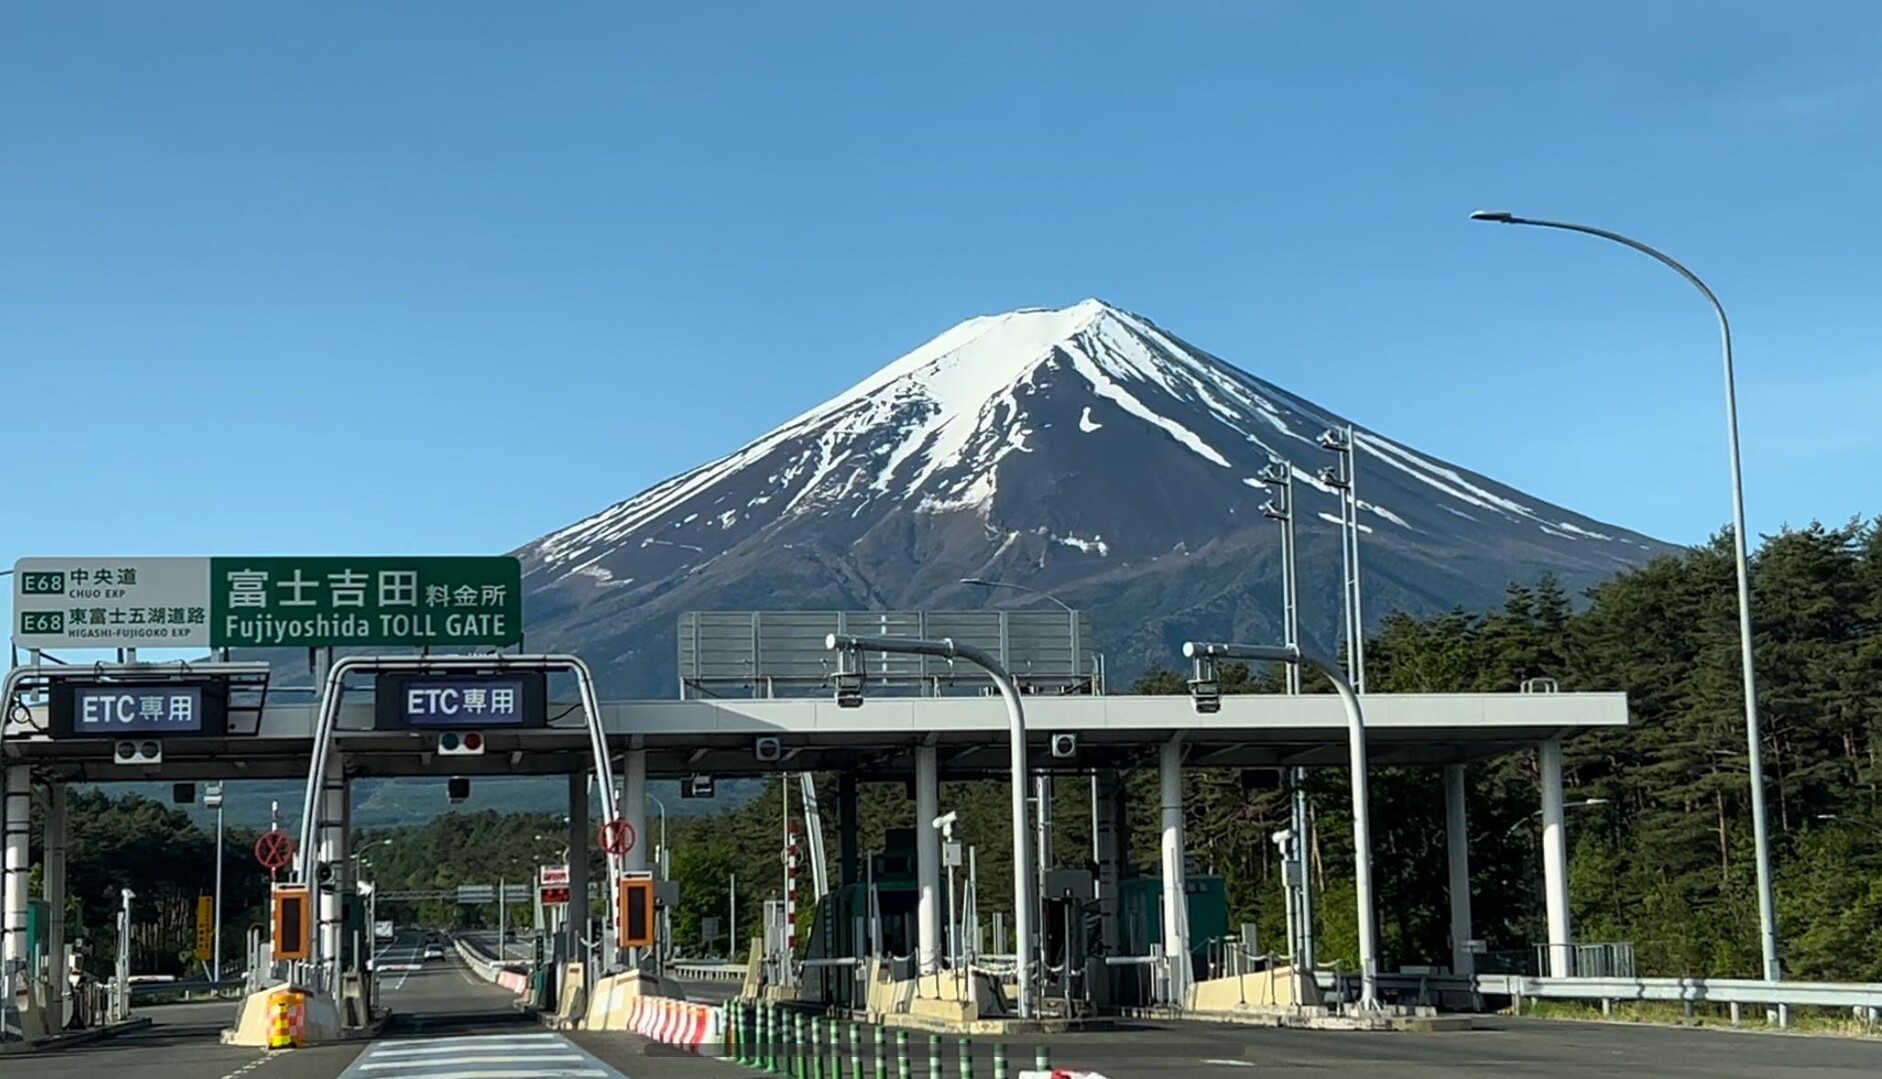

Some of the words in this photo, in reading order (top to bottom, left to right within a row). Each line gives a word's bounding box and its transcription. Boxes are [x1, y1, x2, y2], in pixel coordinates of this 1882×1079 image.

[24, 575, 63, 591] E68
[70, 567, 137, 586] 中央道
[69, 589, 101, 599] CHUO
[105, 589, 126, 599] EXP
[24, 615, 63, 631] E68
[69, 607, 206, 625] 東富士五湖道路
[68, 628, 168, 639] HIGASHI-FUJIGOKO
[171, 628, 192, 638] EXP
[226, 614, 370, 643] Fujiyoshida
[379, 614, 437, 637] TOLL
[445, 614, 506, 637] GATE
